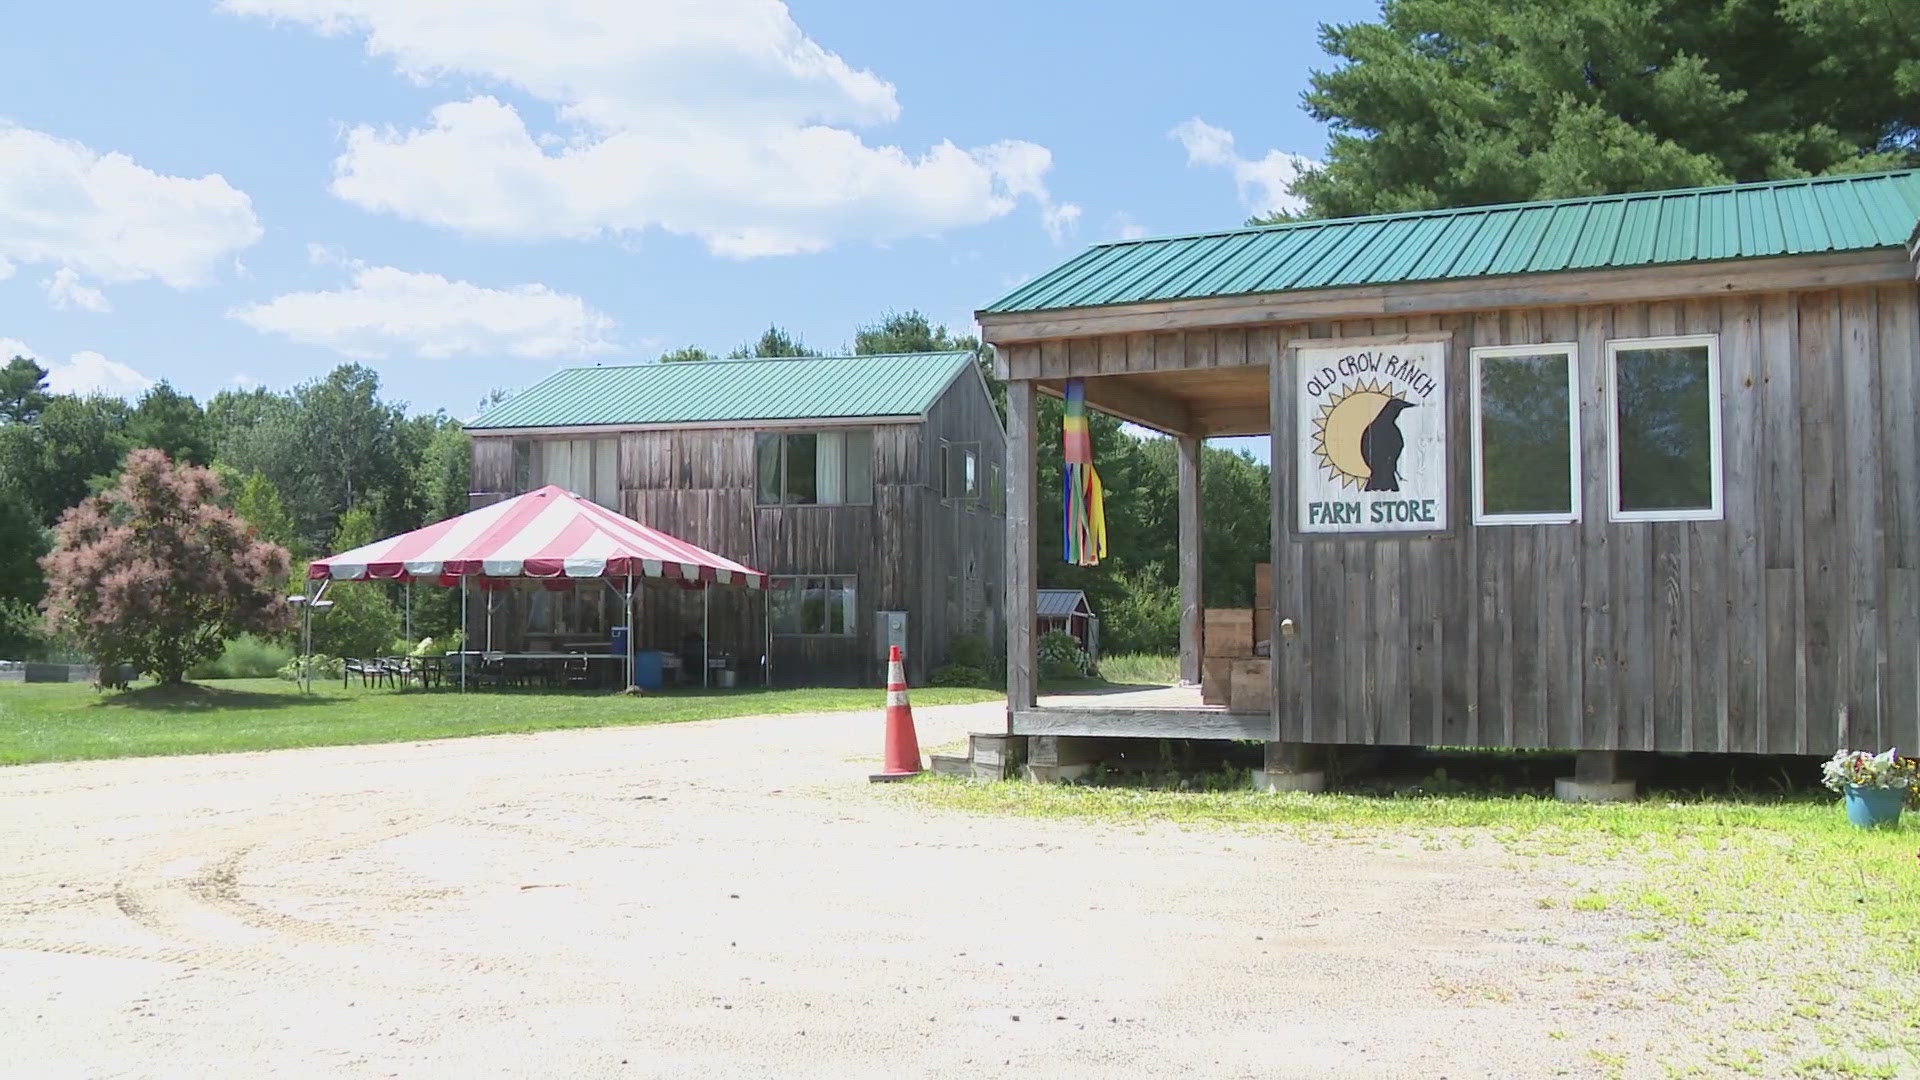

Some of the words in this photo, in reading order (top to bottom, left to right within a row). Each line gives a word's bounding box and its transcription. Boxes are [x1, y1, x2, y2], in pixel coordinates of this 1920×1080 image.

[1307, 367, 1337, 397] OLD
[1338, 351, 1383, 377] CROW
[1385, 355, 1438, 398] RANCH
[1309, 501, 1361, 525] FARM
[1370, 499, 1436, 523] STORE
